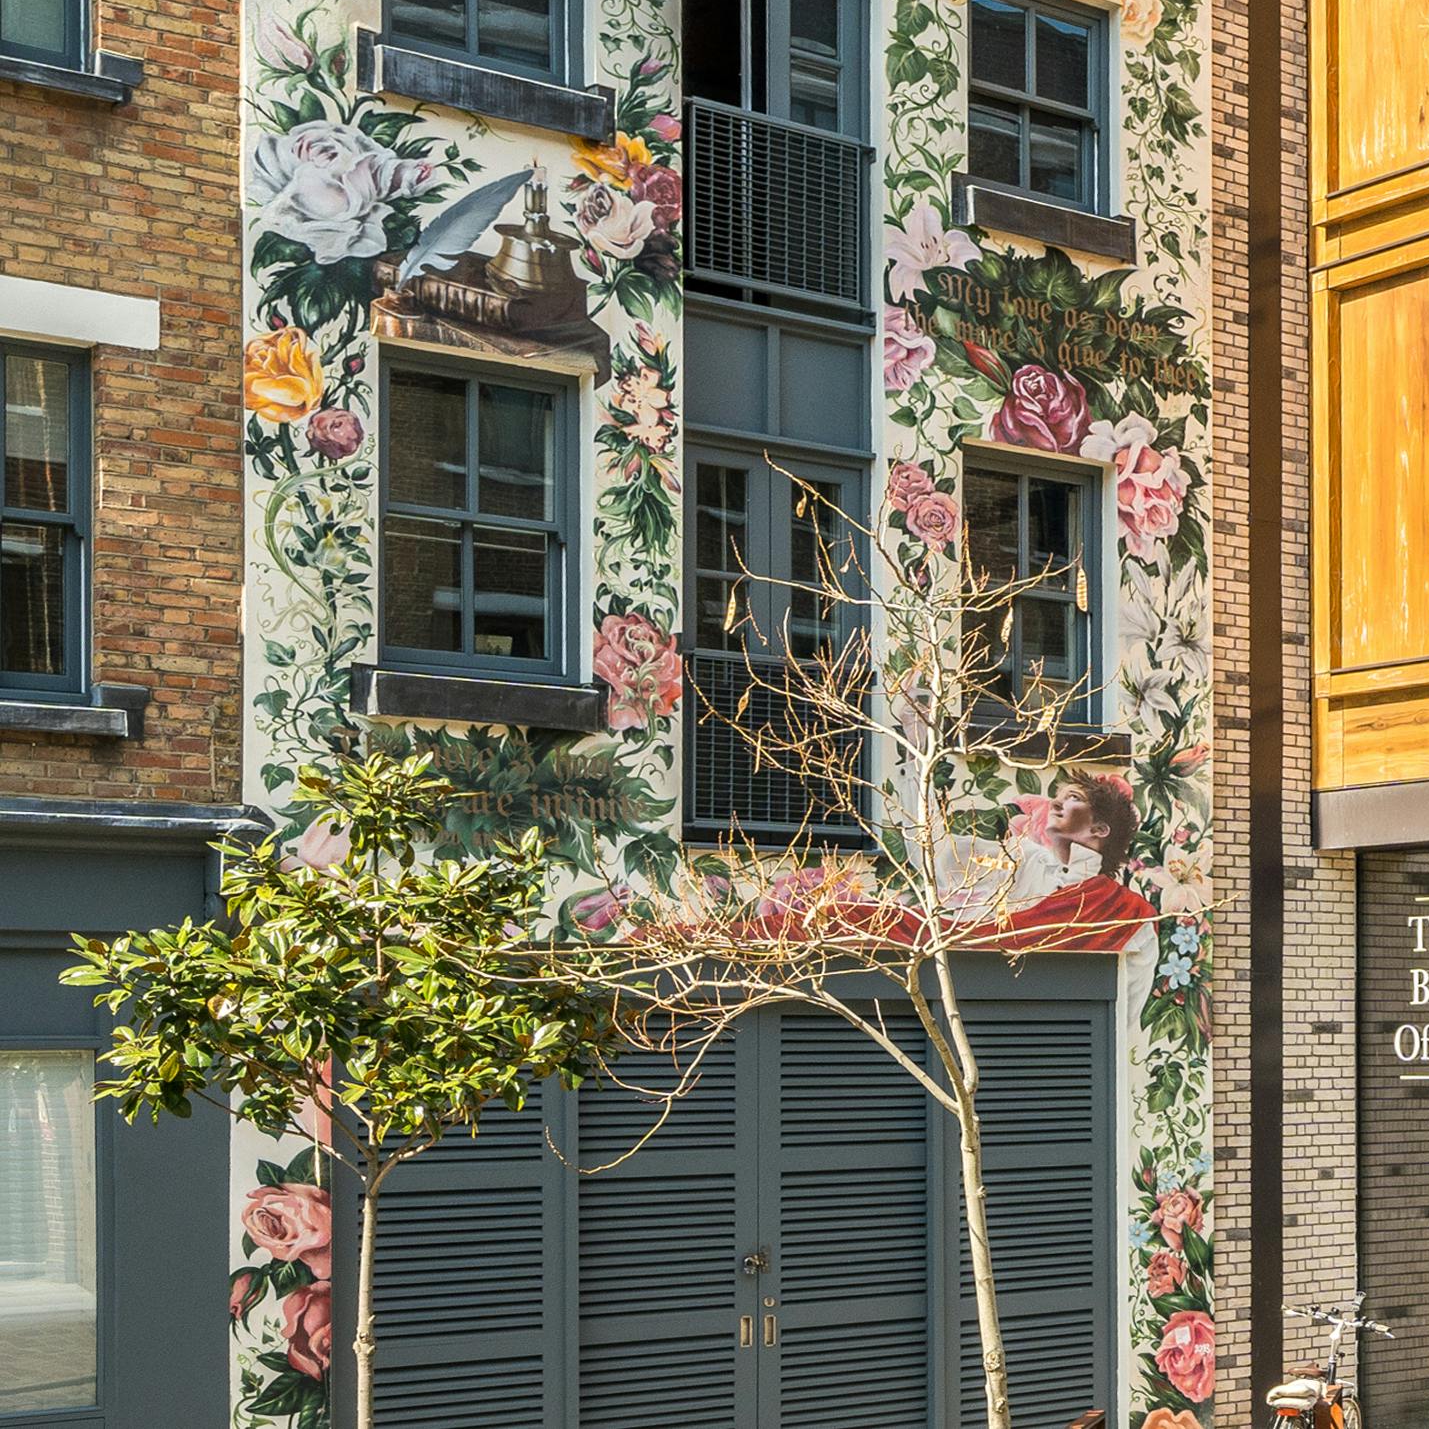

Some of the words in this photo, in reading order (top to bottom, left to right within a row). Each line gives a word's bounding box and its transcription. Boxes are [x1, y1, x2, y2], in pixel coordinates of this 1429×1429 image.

[938, 271, 991, 316] My
[1003, 289, 1052, 324] love
[1065, 307, 1096, 330] as
[904, 300, 942, 337] the
[955, 320, 1016, 352] more
[1028, 325, 1047, 359] I
[1058, 342, 1105, 372] give
[1119, 350, 1141, 379] to
[1155, 357, 1199, 391] thee
[530, 783, 649, 822] infinite
